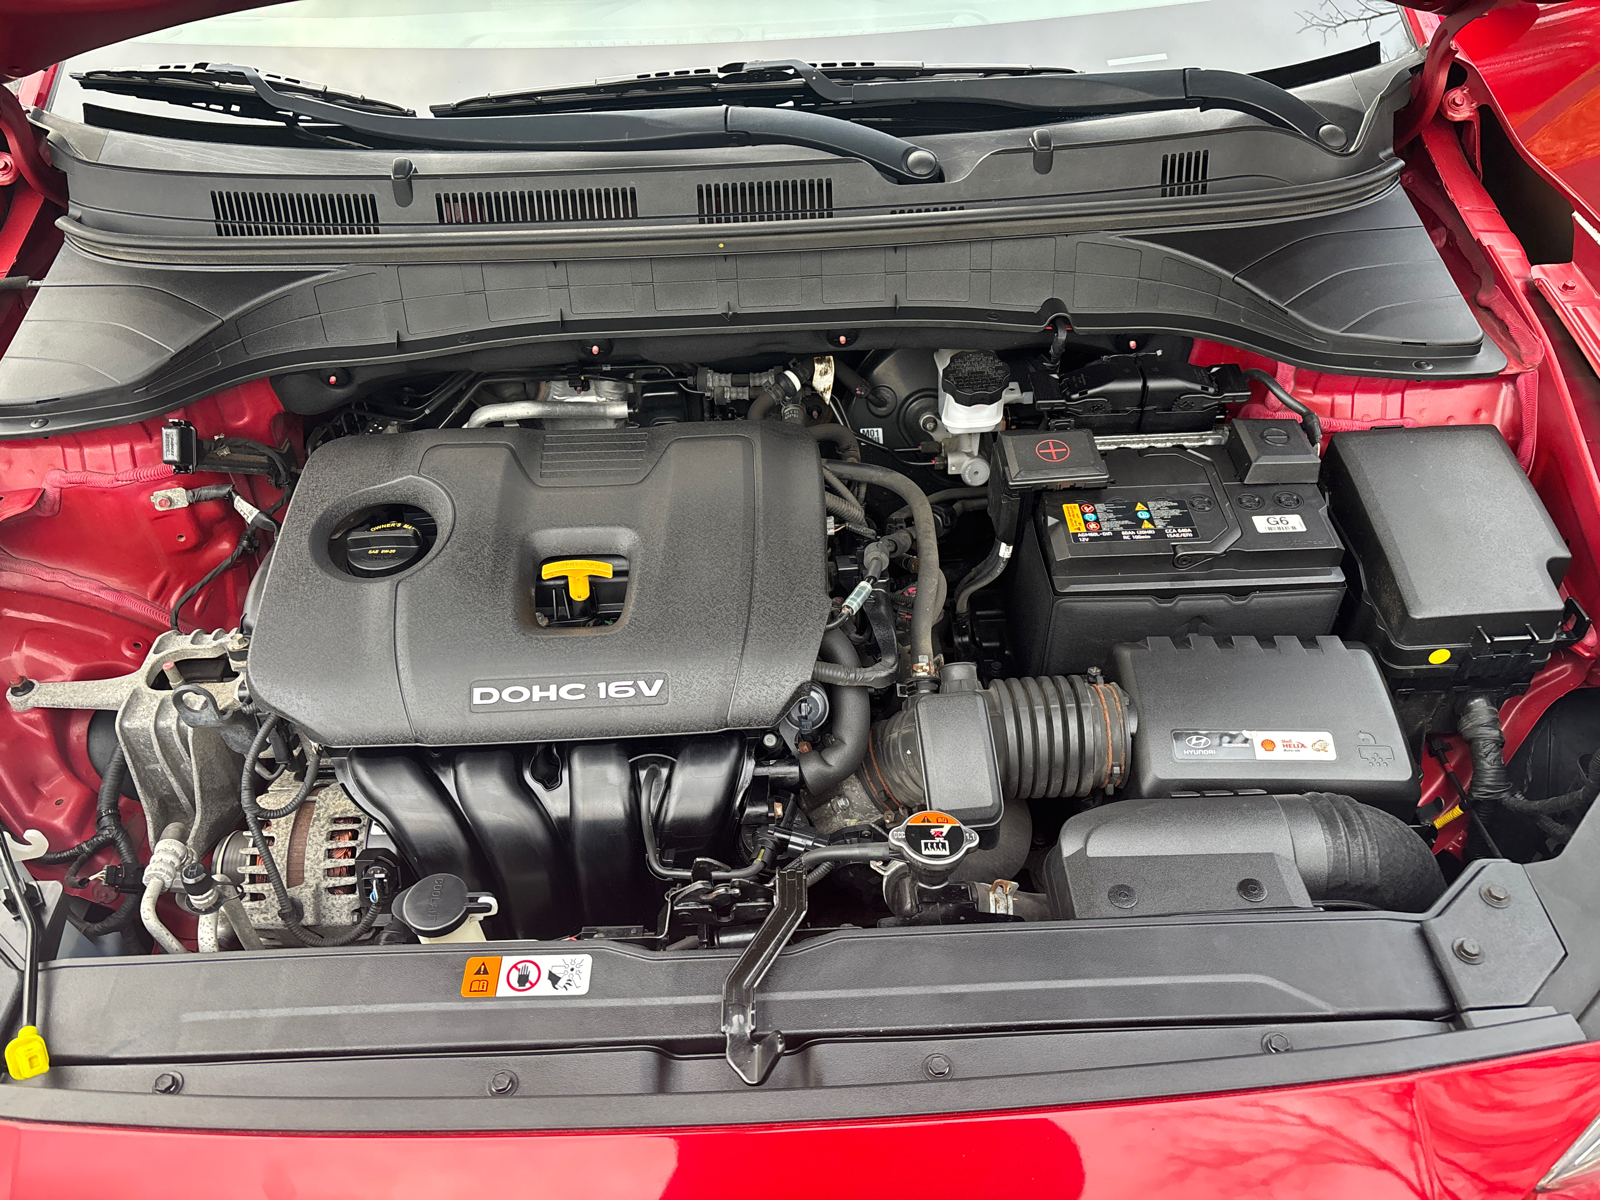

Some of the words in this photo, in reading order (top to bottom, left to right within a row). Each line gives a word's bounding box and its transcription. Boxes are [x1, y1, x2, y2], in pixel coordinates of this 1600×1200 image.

[1266, 516, 1289, 526] G6
[370, 523, 401, 532] OWNER'S
[472, 683, 587, 705] DOHC
[597, 679, 664, 699] 16V
[965, 832, 976, 840] 1.1
